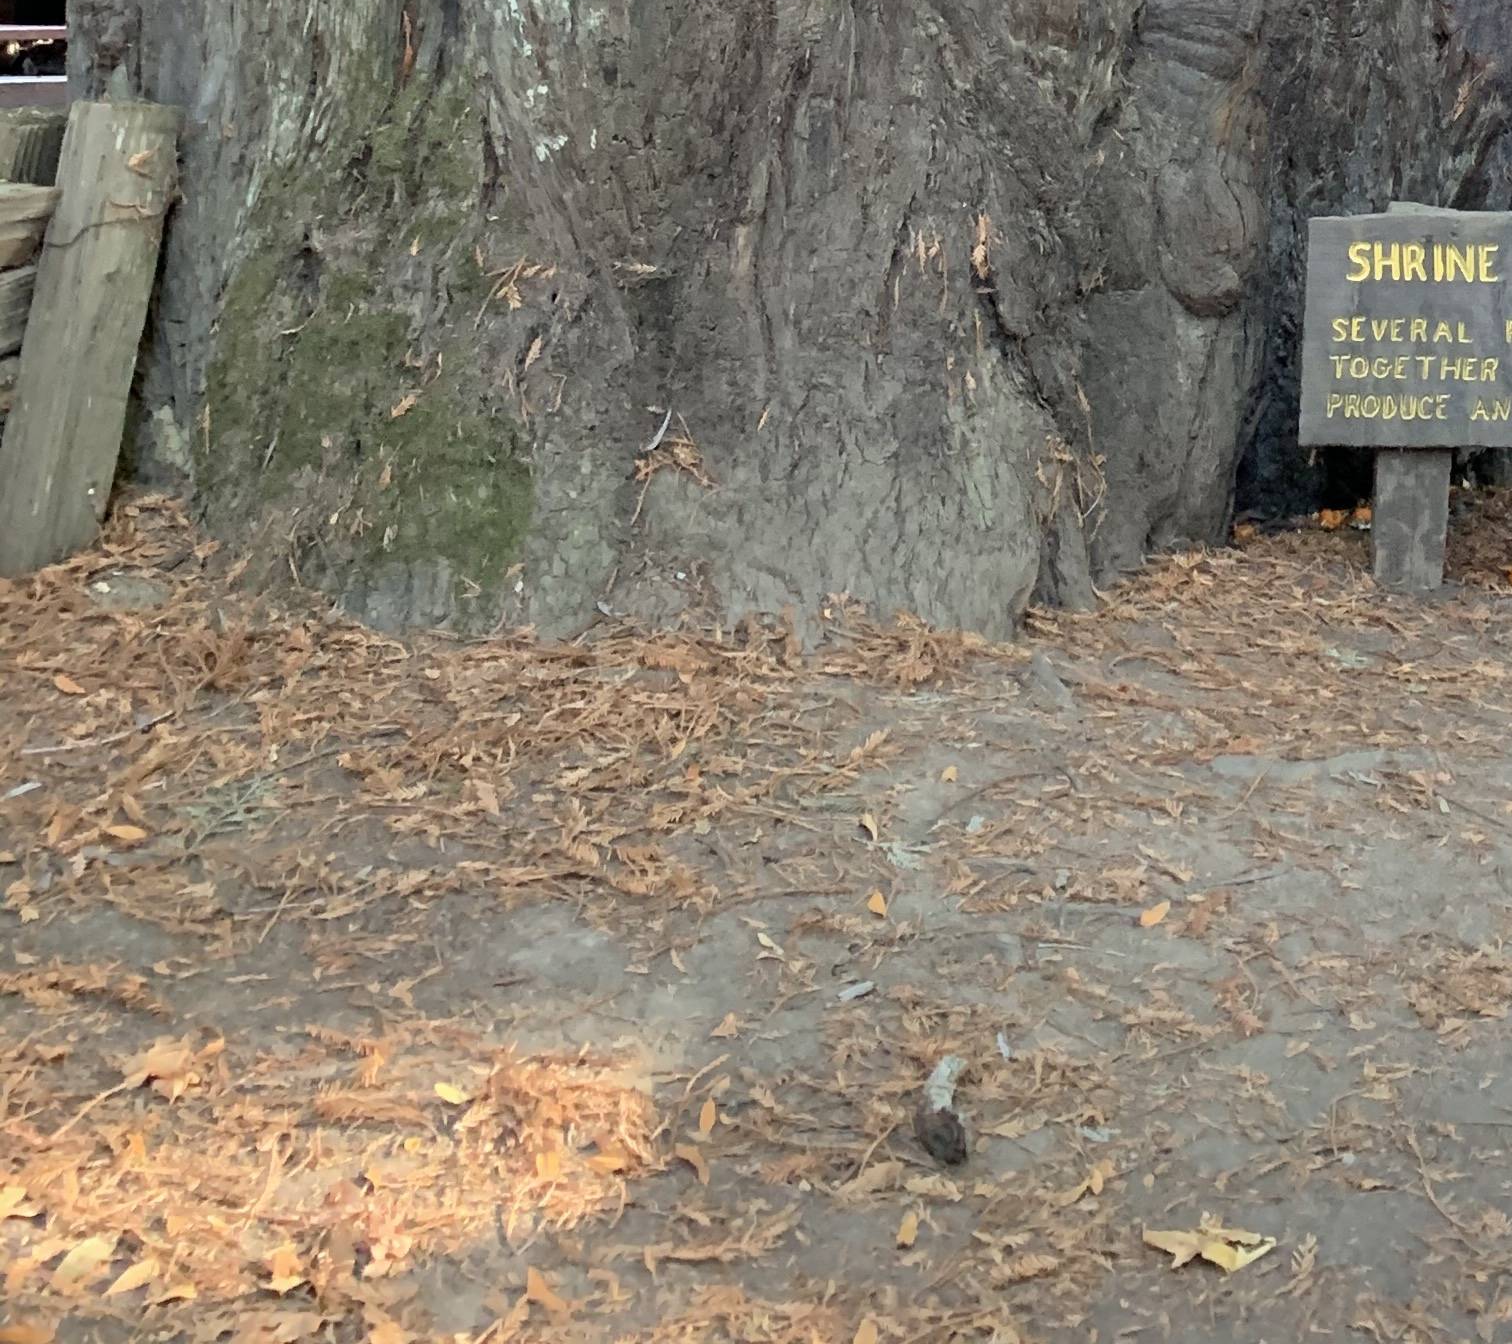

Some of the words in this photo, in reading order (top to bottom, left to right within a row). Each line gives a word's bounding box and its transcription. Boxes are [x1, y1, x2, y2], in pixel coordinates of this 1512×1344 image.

[1347, 241, 1499, 284] SHRINE
[1331, 317, 1473, 344] SEVERAL
[1329, 355, 1499, 382] TOGETHER
[1327, 392, 1452, 422] PRODUCE
[1470, 397, 1511, 422] AN
